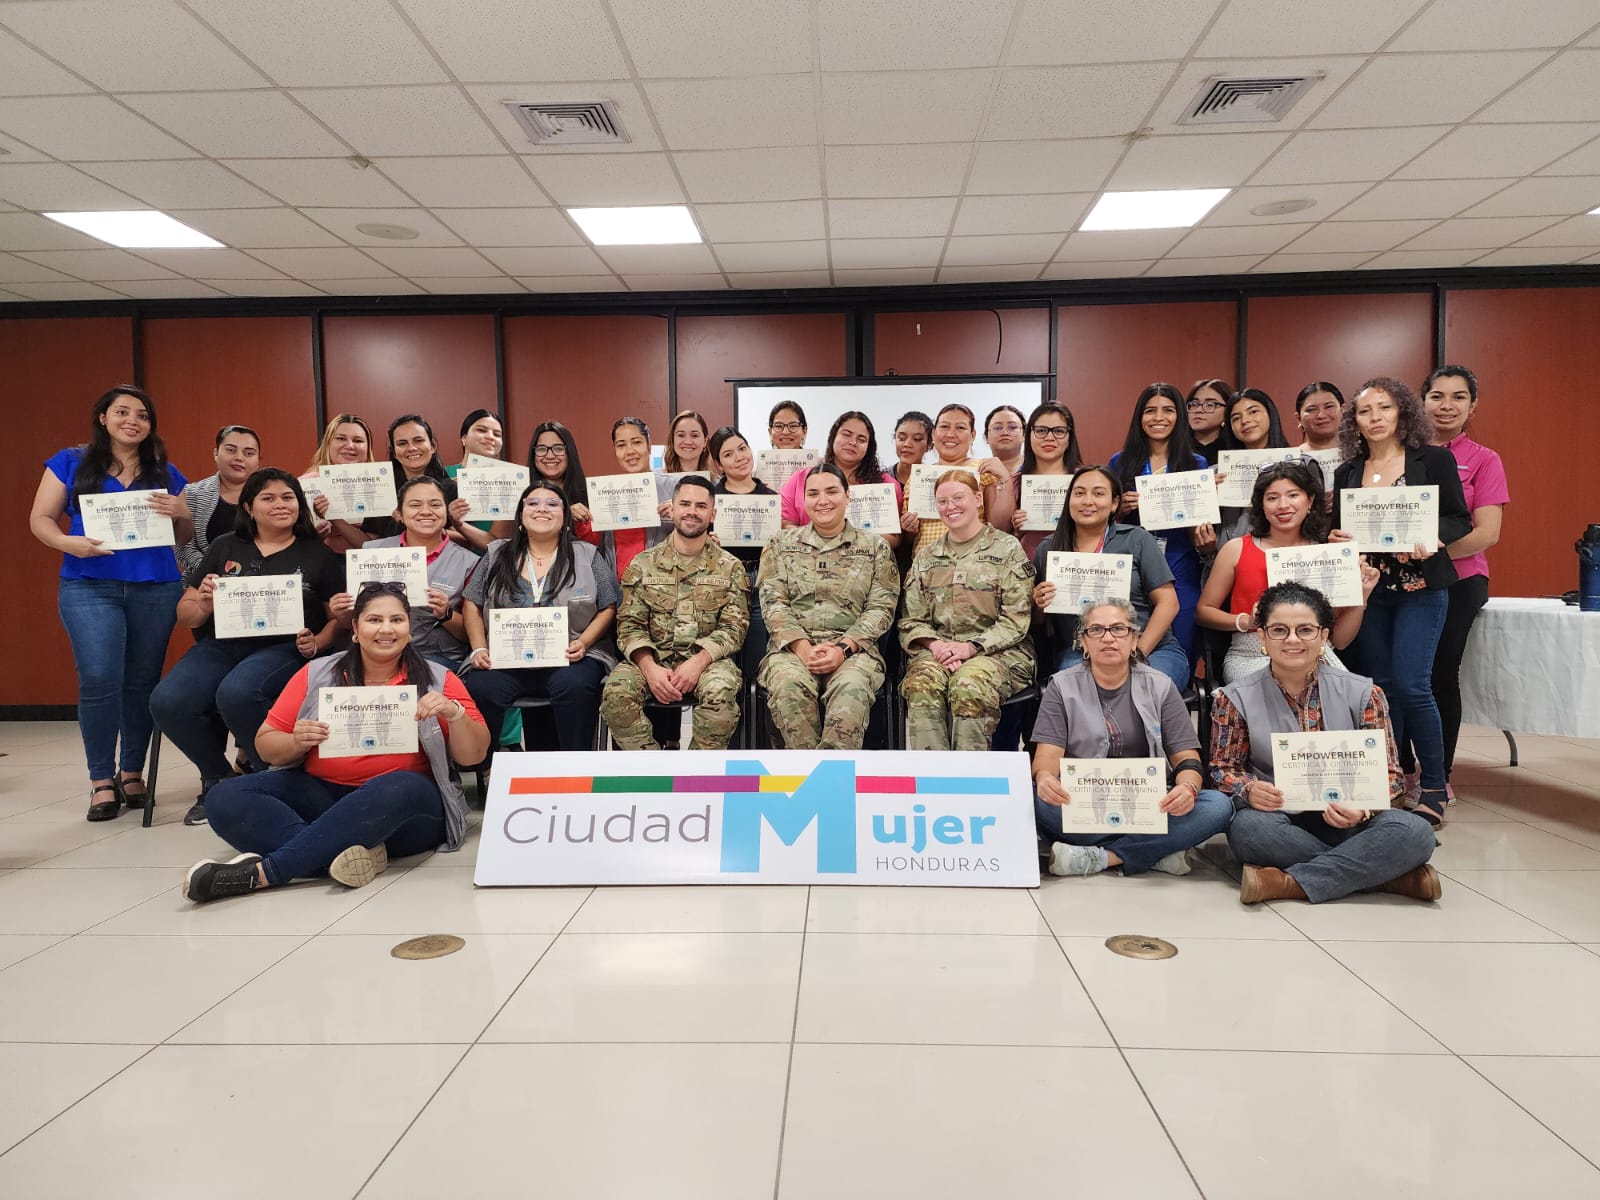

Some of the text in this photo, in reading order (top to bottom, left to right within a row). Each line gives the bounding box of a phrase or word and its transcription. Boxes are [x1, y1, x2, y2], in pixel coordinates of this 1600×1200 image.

[1149, 484, 1202, 493] EMPOWERHER
[1355, 502, 1420, 511] EMPOWERHER
[359, 562, 412, 570] EMPOWERHER
[1281, 558, 1343, 569] EMPOWERHER
[1060, 566, 1116, 576] EMPOWERHER
[227, 589, 287, 599] EMPOWERHER
[501, 621, 554, 630] EMPOWERHER
[334, 703, 400, 713] EMPOWERHER
[1291, 750, 1366, 761] EMPOWERHER
[1281, 761, 1328, 769] CERTIFICATE
[1342, 759, 1378, 768] TRAINING
[1077, 778, 1148, 786] EMPOWERHER
[503, 805, 711, 844] Ciudad
[876, 857, 1000, 871] HONDURAS
